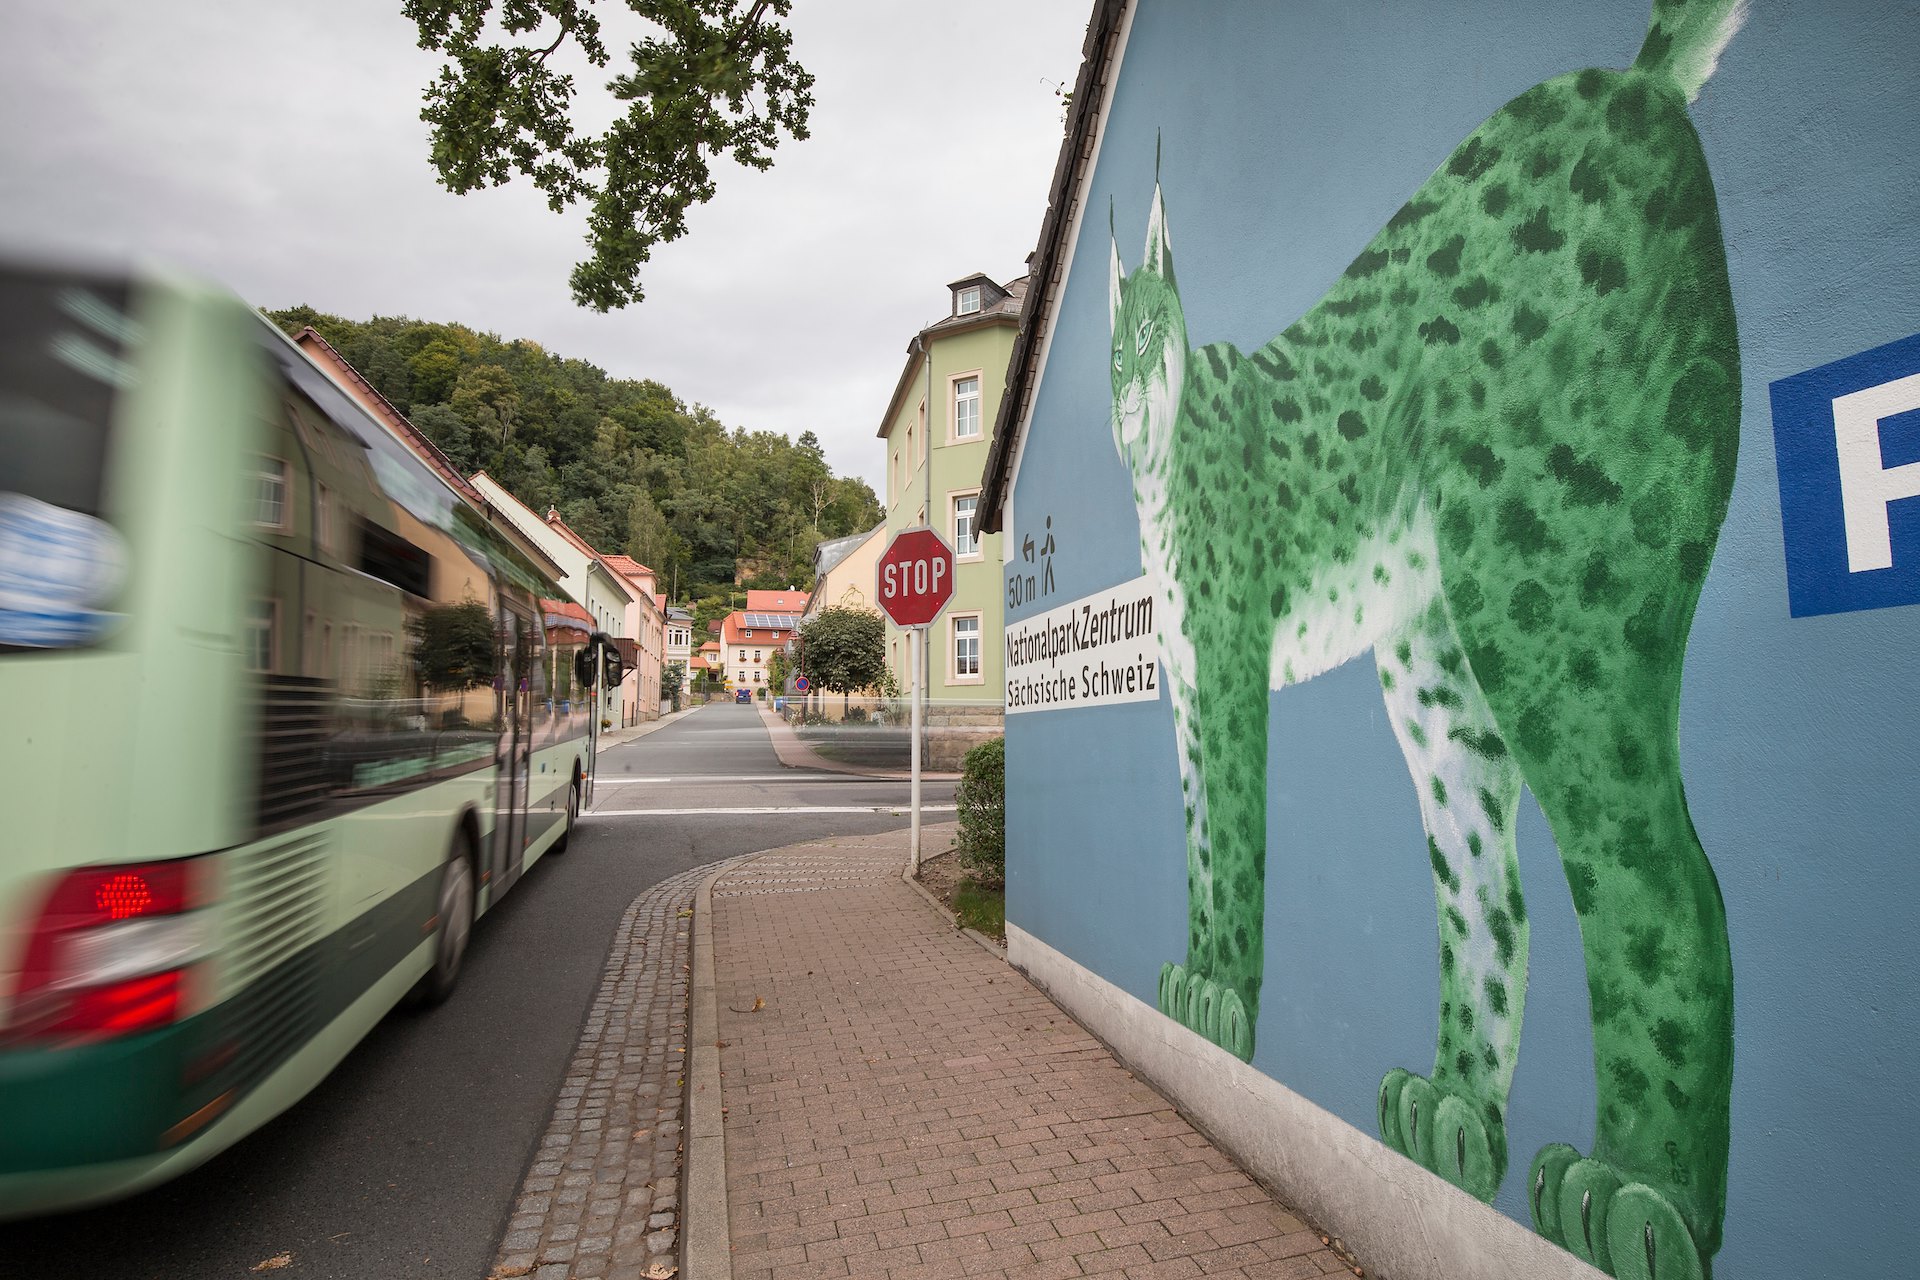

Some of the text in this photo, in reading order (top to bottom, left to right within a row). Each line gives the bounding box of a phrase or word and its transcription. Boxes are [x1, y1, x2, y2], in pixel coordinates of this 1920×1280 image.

[884, 556, 945, 598] STOP
[1008, 574, 1036, 609] 50 m
[1007, 595, 1153, 668] NationalparkZentrum
[1008, 653, 1155, 707] Sächsische Schweiz
